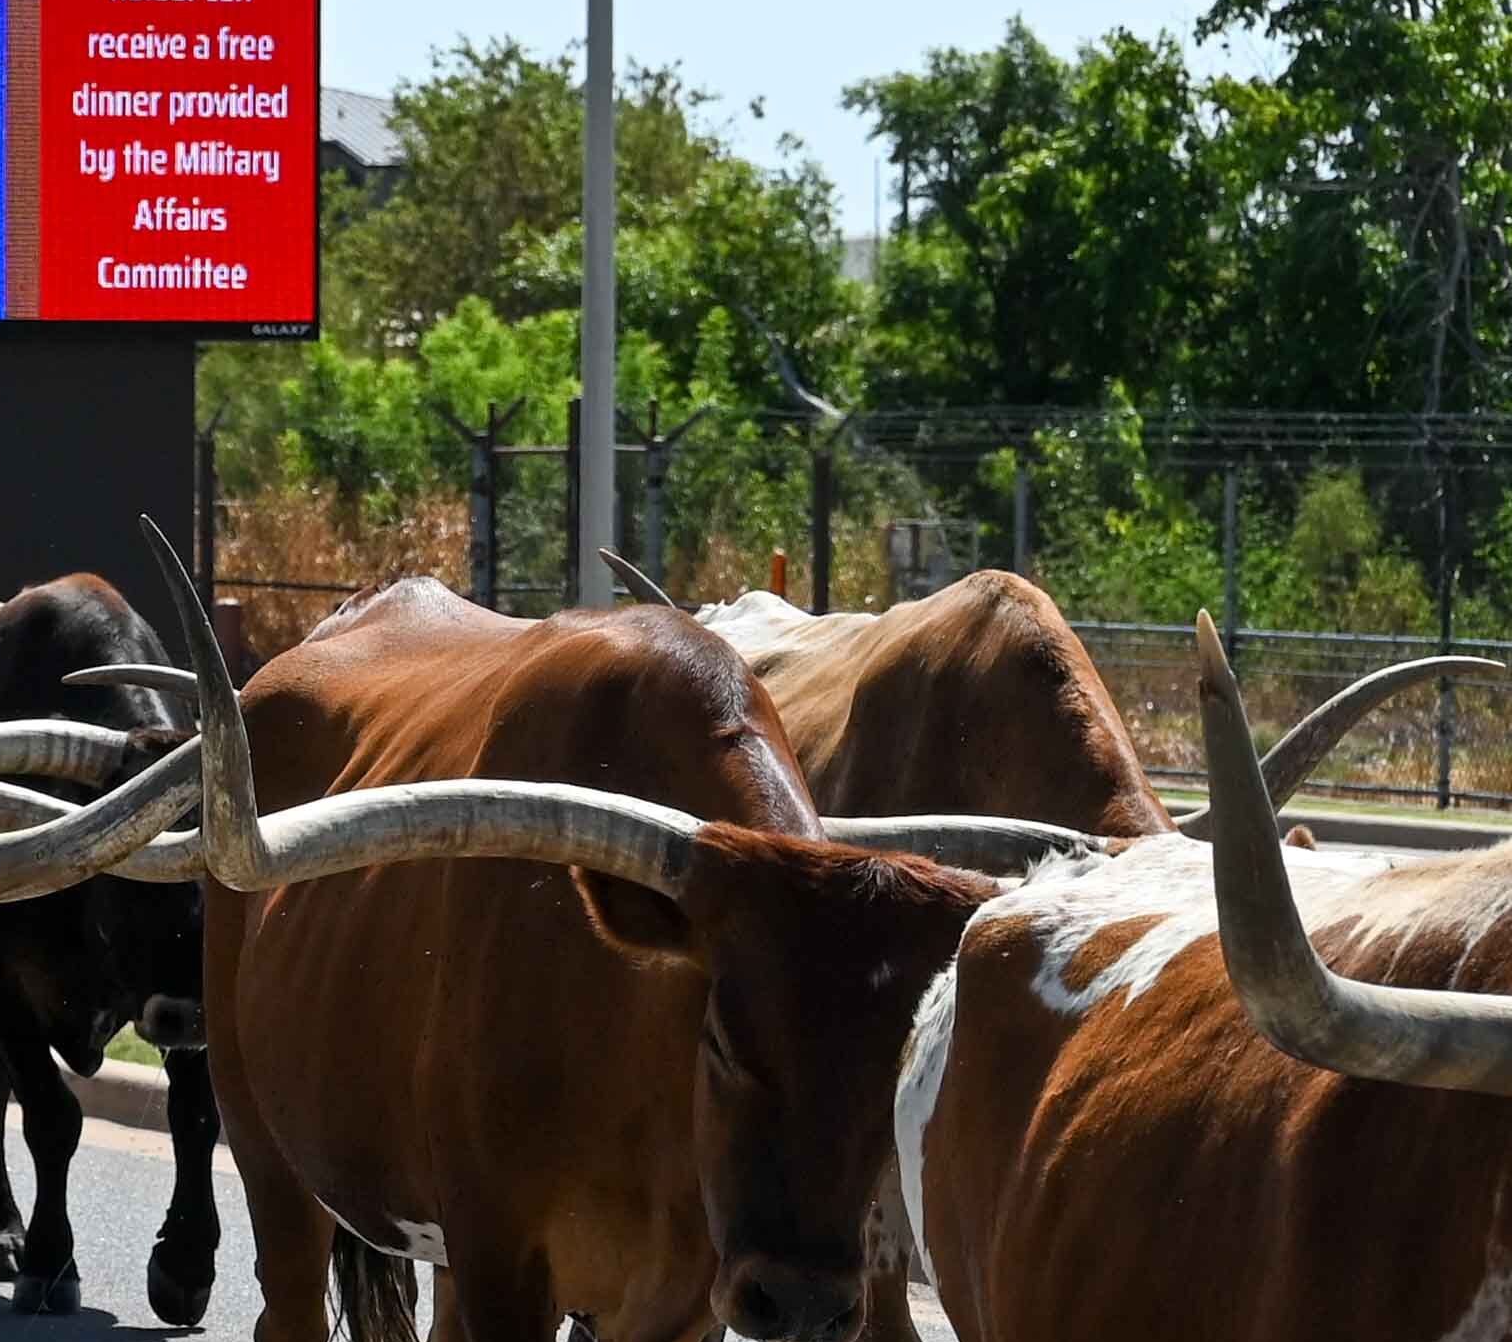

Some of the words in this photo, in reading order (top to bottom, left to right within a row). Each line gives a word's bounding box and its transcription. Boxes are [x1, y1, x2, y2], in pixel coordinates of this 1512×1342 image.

[89, 25, 186, 59] receive
[194, 35, 209, 59] a
[218, 27, 274, 60] free
[73, 83, 161, 116] dinner
[170, 84, 287, 124] provided
[81, 141, 114, 181] by
[123, 141, 167, 174] the
[175, 142, 279, 182] Military
[134, 197, 226, 230] Affairs
[98, 256, 247, 288] Committee
